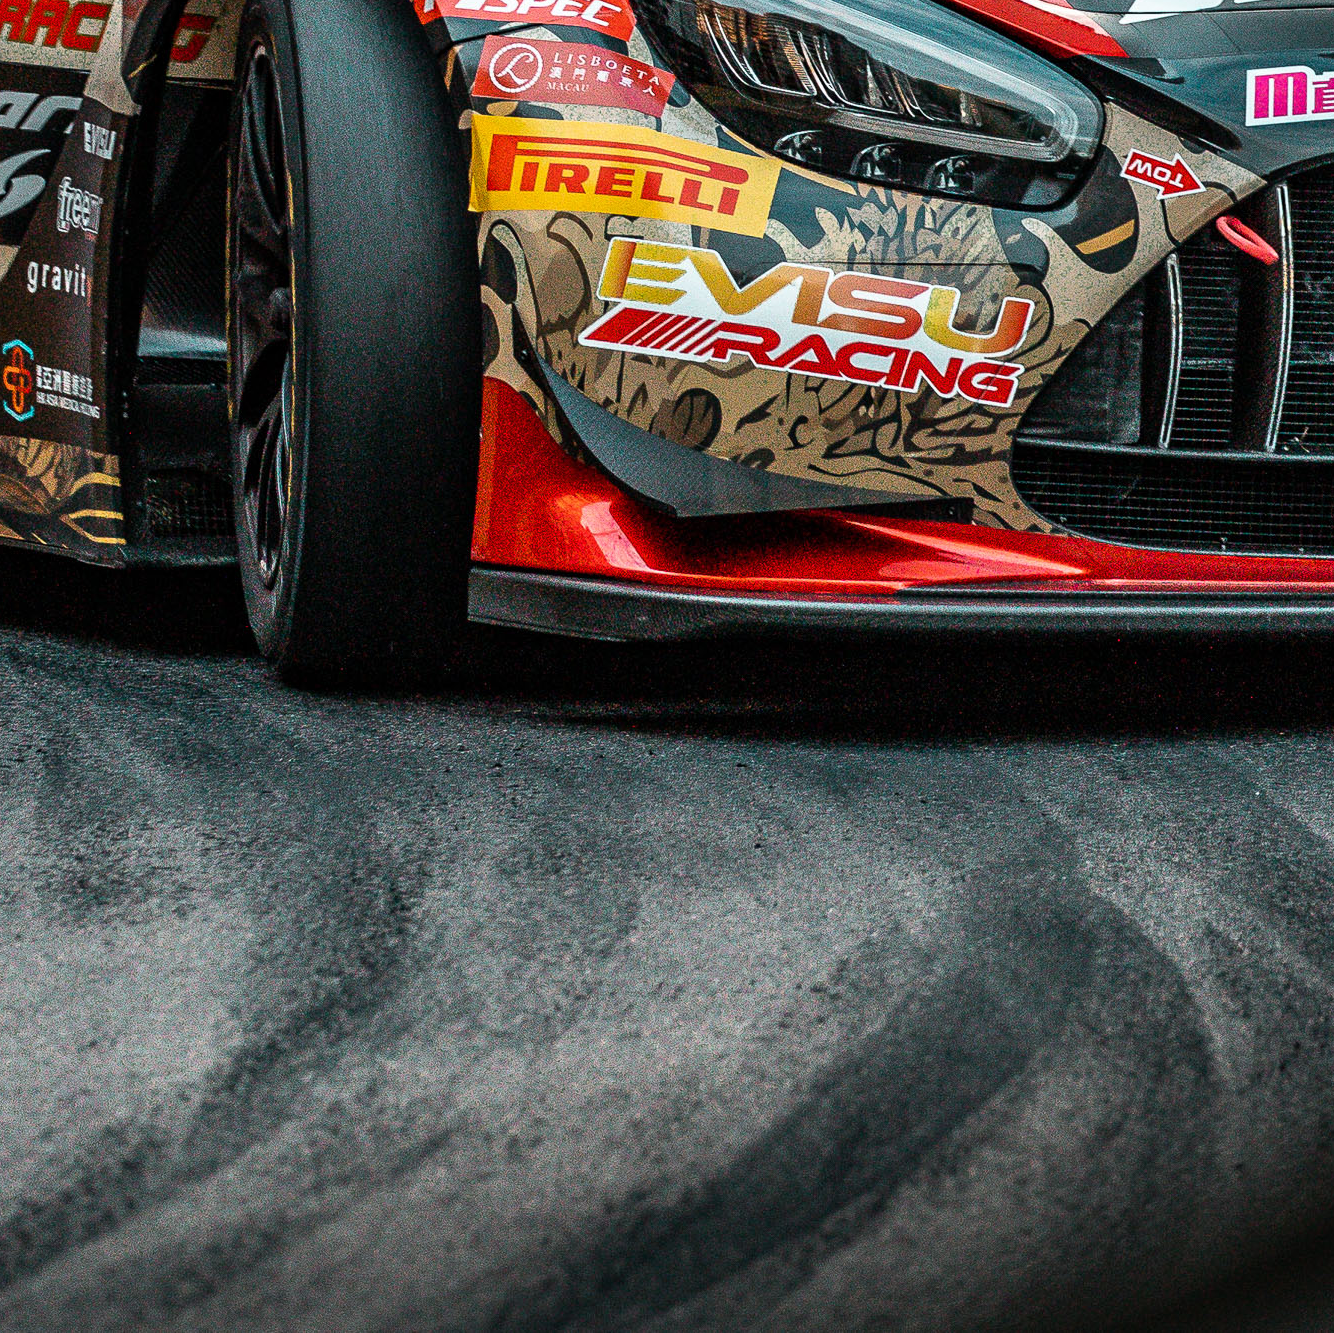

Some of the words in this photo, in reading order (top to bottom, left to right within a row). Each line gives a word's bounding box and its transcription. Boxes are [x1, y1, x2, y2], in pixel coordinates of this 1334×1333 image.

[545, 81, 590, 93] MACAU
[553, 52, 661, 86] LISBOETA
[486, 133, 750, 217] PIRELLI
[1127, 158, 1184, 189] TOW
[599, 239, 1032, 355] EVISU
[700, 319, 1023, 405] RACING
